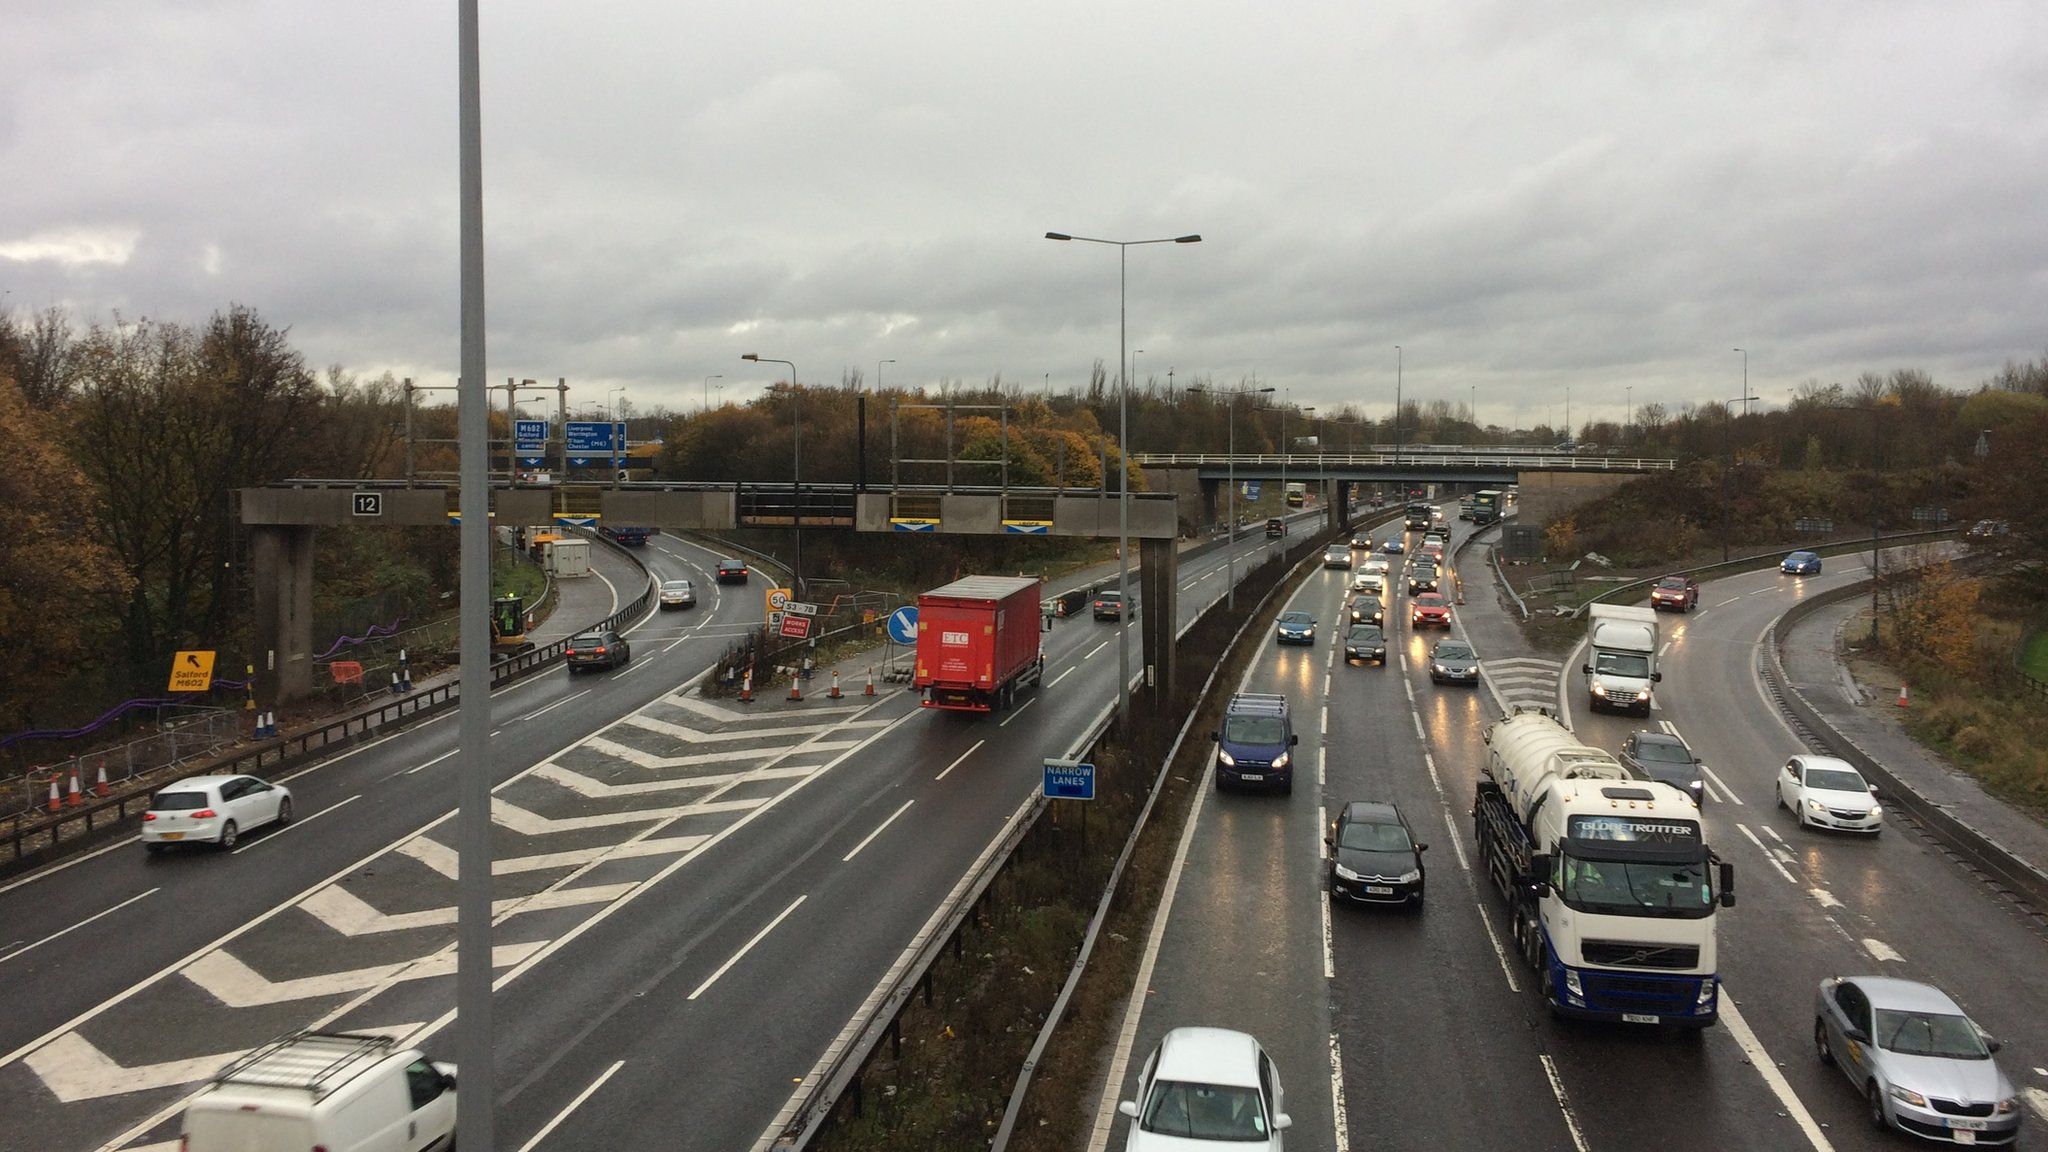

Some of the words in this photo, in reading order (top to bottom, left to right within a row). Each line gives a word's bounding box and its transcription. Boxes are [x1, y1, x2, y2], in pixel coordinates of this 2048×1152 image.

[359, 497, 376, 512] 12
[772, 595, 785, 604] 50
[786, 620, 807, 628] WORKS
[175, 670, 208, 679] Salford
[175, 679, 204, 687] M602
[1046, 766, 1091, 777] NARROW
[1052, 776, 1085, 787] LANES
[1577, 821, 1692, 836] GLOBETROTTER
